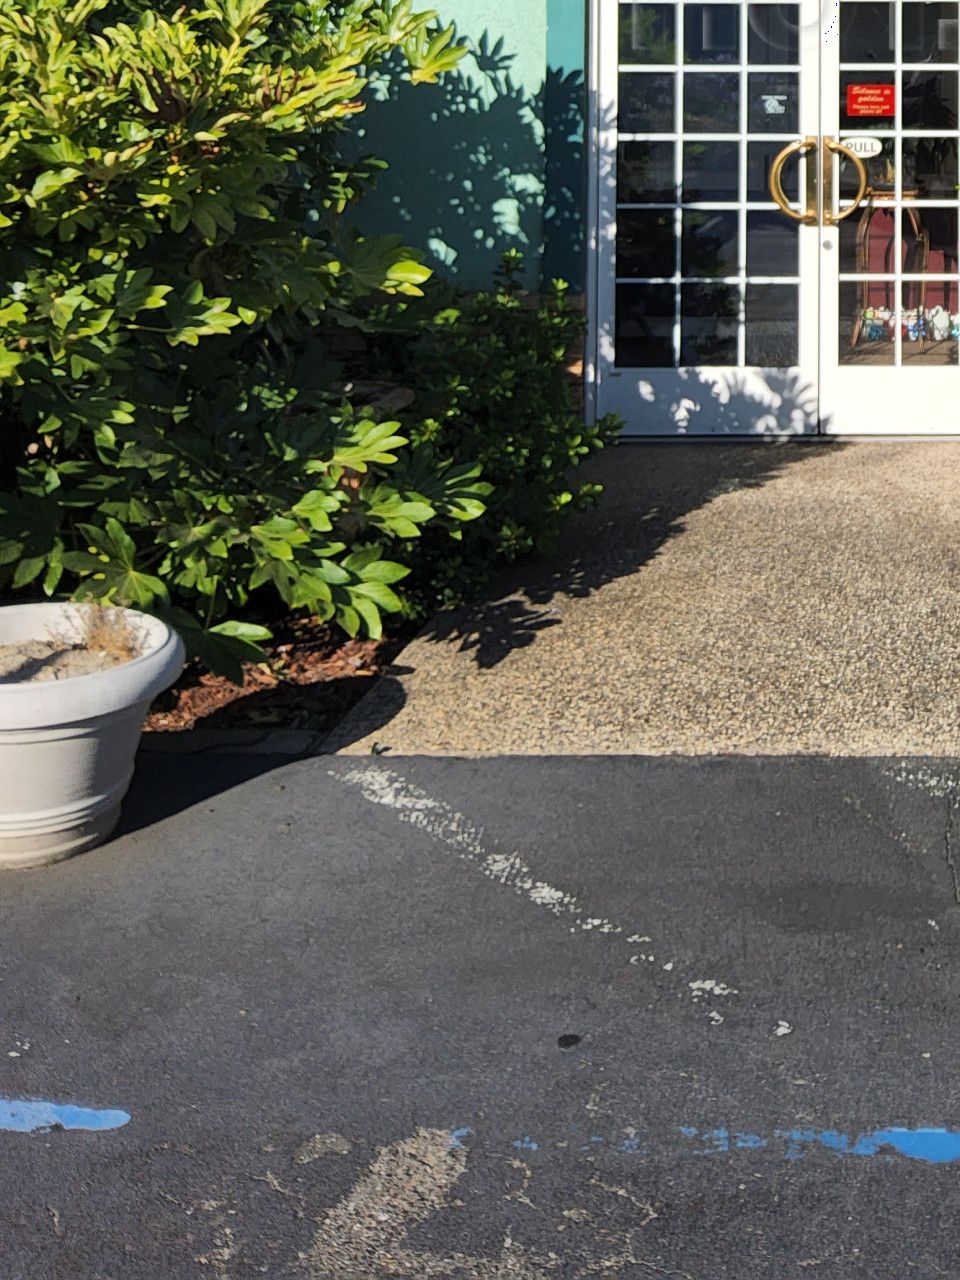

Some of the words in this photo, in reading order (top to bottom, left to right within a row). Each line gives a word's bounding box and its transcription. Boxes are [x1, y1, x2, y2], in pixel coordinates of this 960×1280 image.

[853, 86, 881, 94] Silence
[858, 95, 884, 103] golden
[846, 142, 877, 153] PULL
